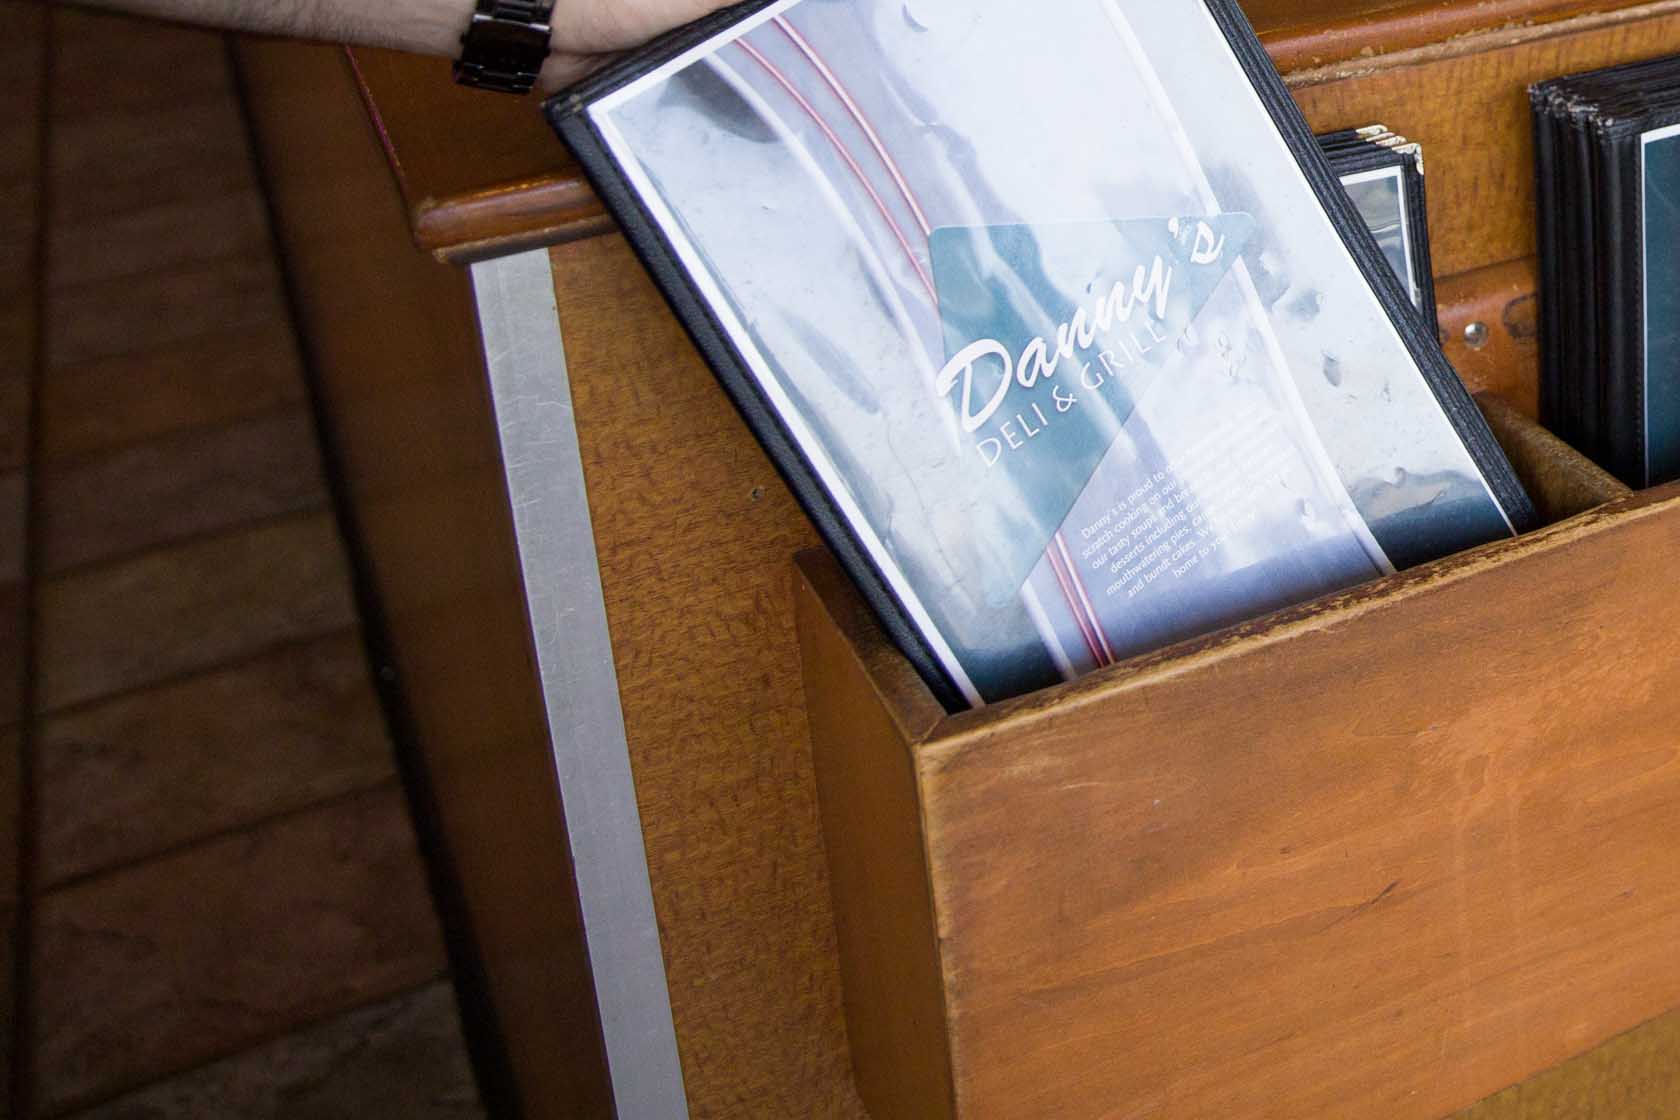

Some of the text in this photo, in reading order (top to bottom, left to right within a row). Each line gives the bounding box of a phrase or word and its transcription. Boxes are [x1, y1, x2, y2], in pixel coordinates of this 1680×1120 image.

[936, 216, 1225, 432] Danny's
[975, 318, 1168, 467] DELI & GRILL
[1128, 478, 1154, 505] proud
[1153, 471, 1165, 483] to
[1082, 529, 1114, 559] scratch
[1161, 479, 1178, 495] our
[1110, 542, 1145, 574] desserts
[1145, 510, 1185, 545] including
[1092, 554, 1108, 569] our
[1108, 535, 1130, 556] tasty
[1106, 542, 1170, 596] mouthwatering
[1127, 578, 1145, 598] and
[1143, 558, 1170, 583] bundt
[1173, 555, 1199, 578] home
